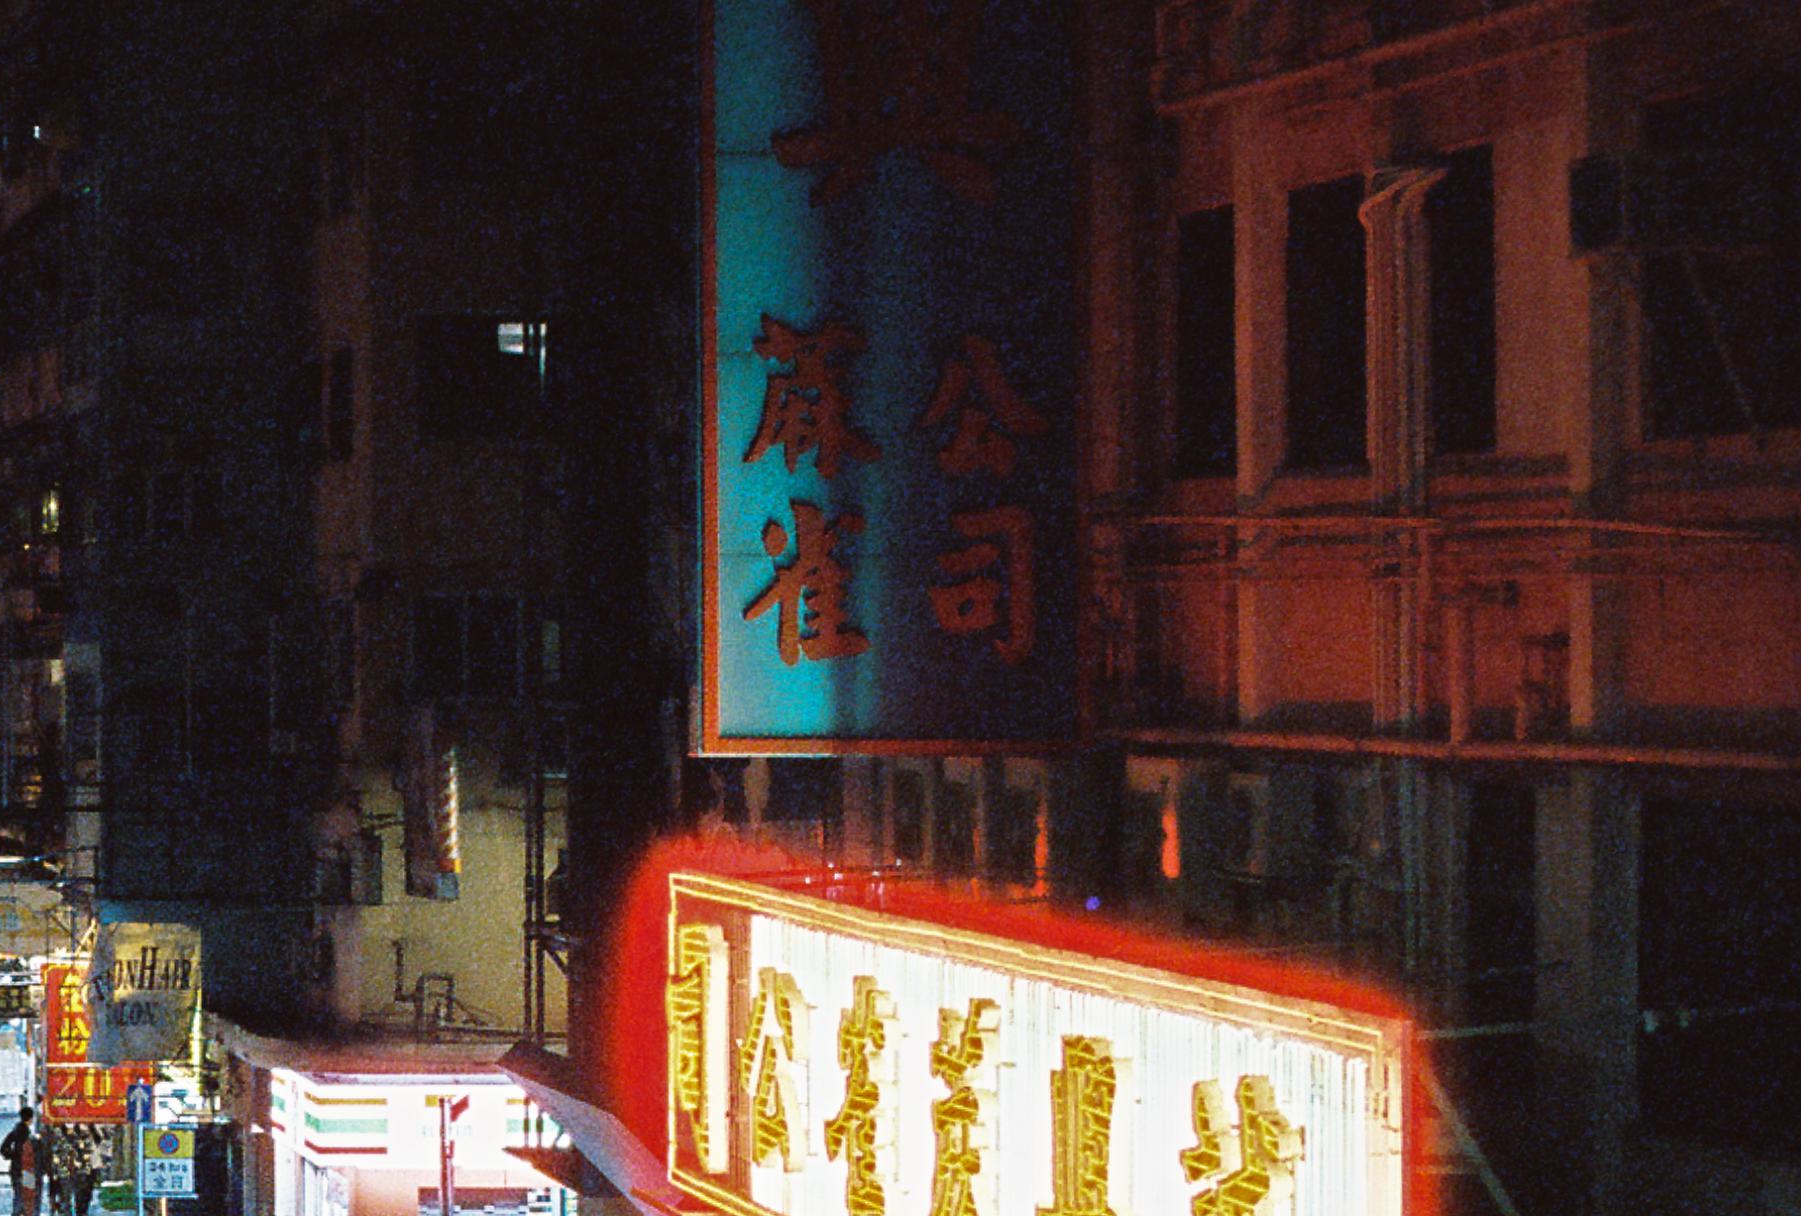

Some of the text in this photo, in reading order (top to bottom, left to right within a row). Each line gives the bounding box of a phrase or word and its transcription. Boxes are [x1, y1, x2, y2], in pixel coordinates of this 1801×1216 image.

[743, 312, 882, 665] 麻雀
[919, 334, 1051, 666] 公司
[149, 1161, 164, 1173] 24
